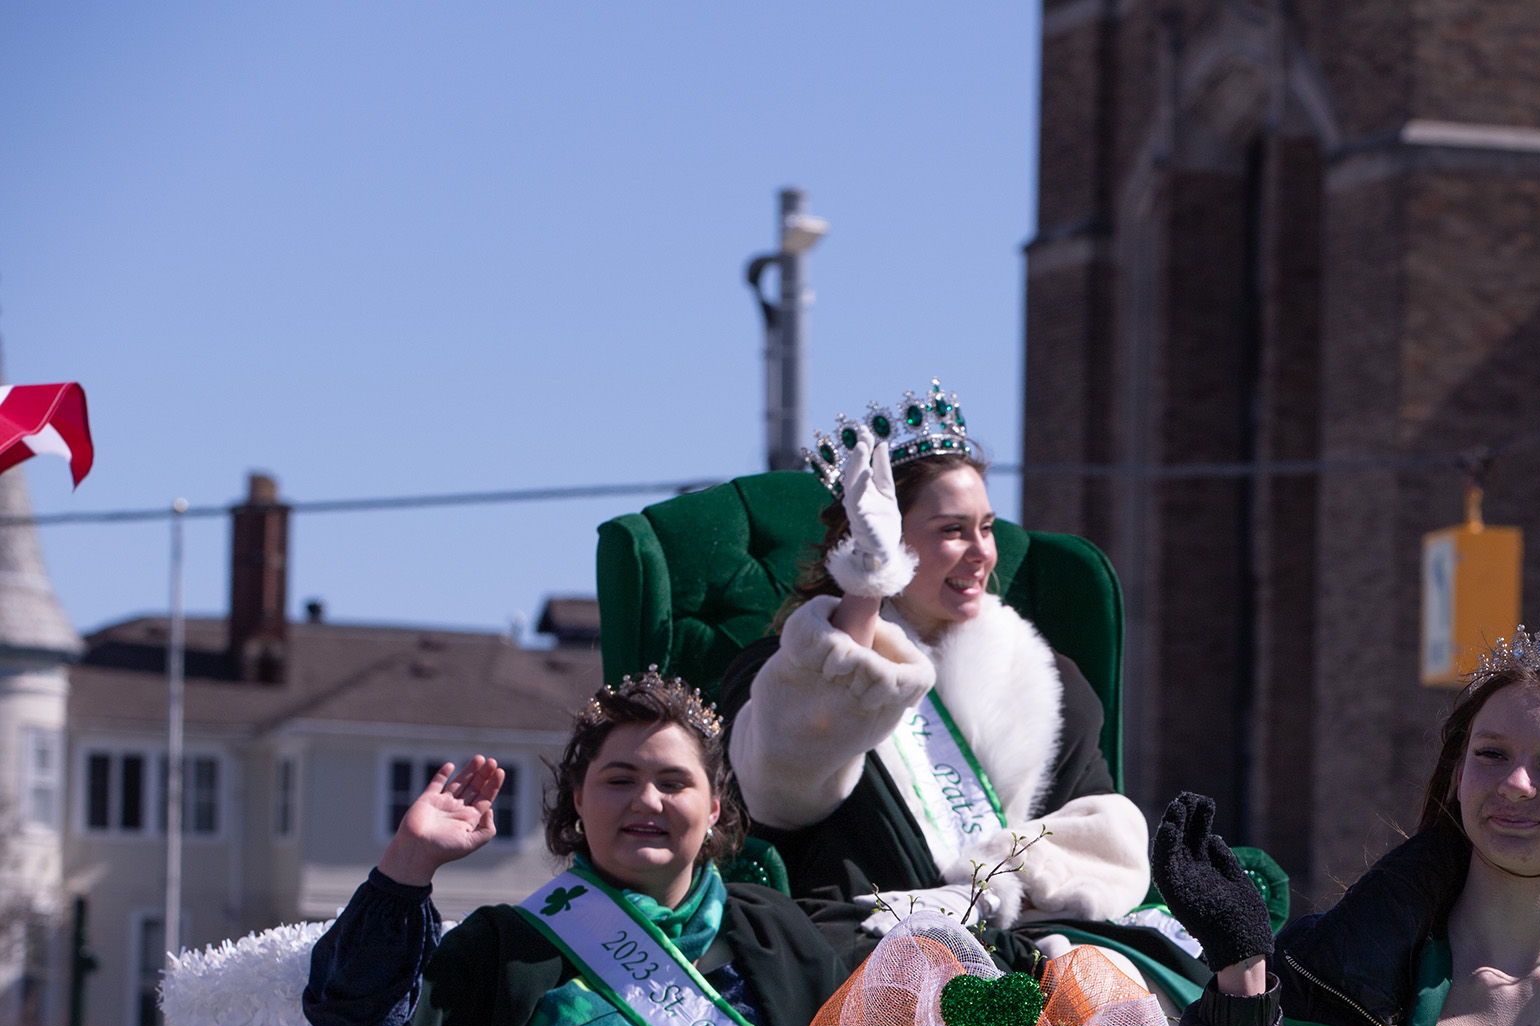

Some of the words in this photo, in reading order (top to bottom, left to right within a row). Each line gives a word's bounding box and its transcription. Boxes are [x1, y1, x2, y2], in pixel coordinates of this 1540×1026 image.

[908, 712, 933, 748] St.
[932, 762, 984, 835] Pat's
[601, 930, 660, 981] 2023
[649, 983, 686, 1018] St.
